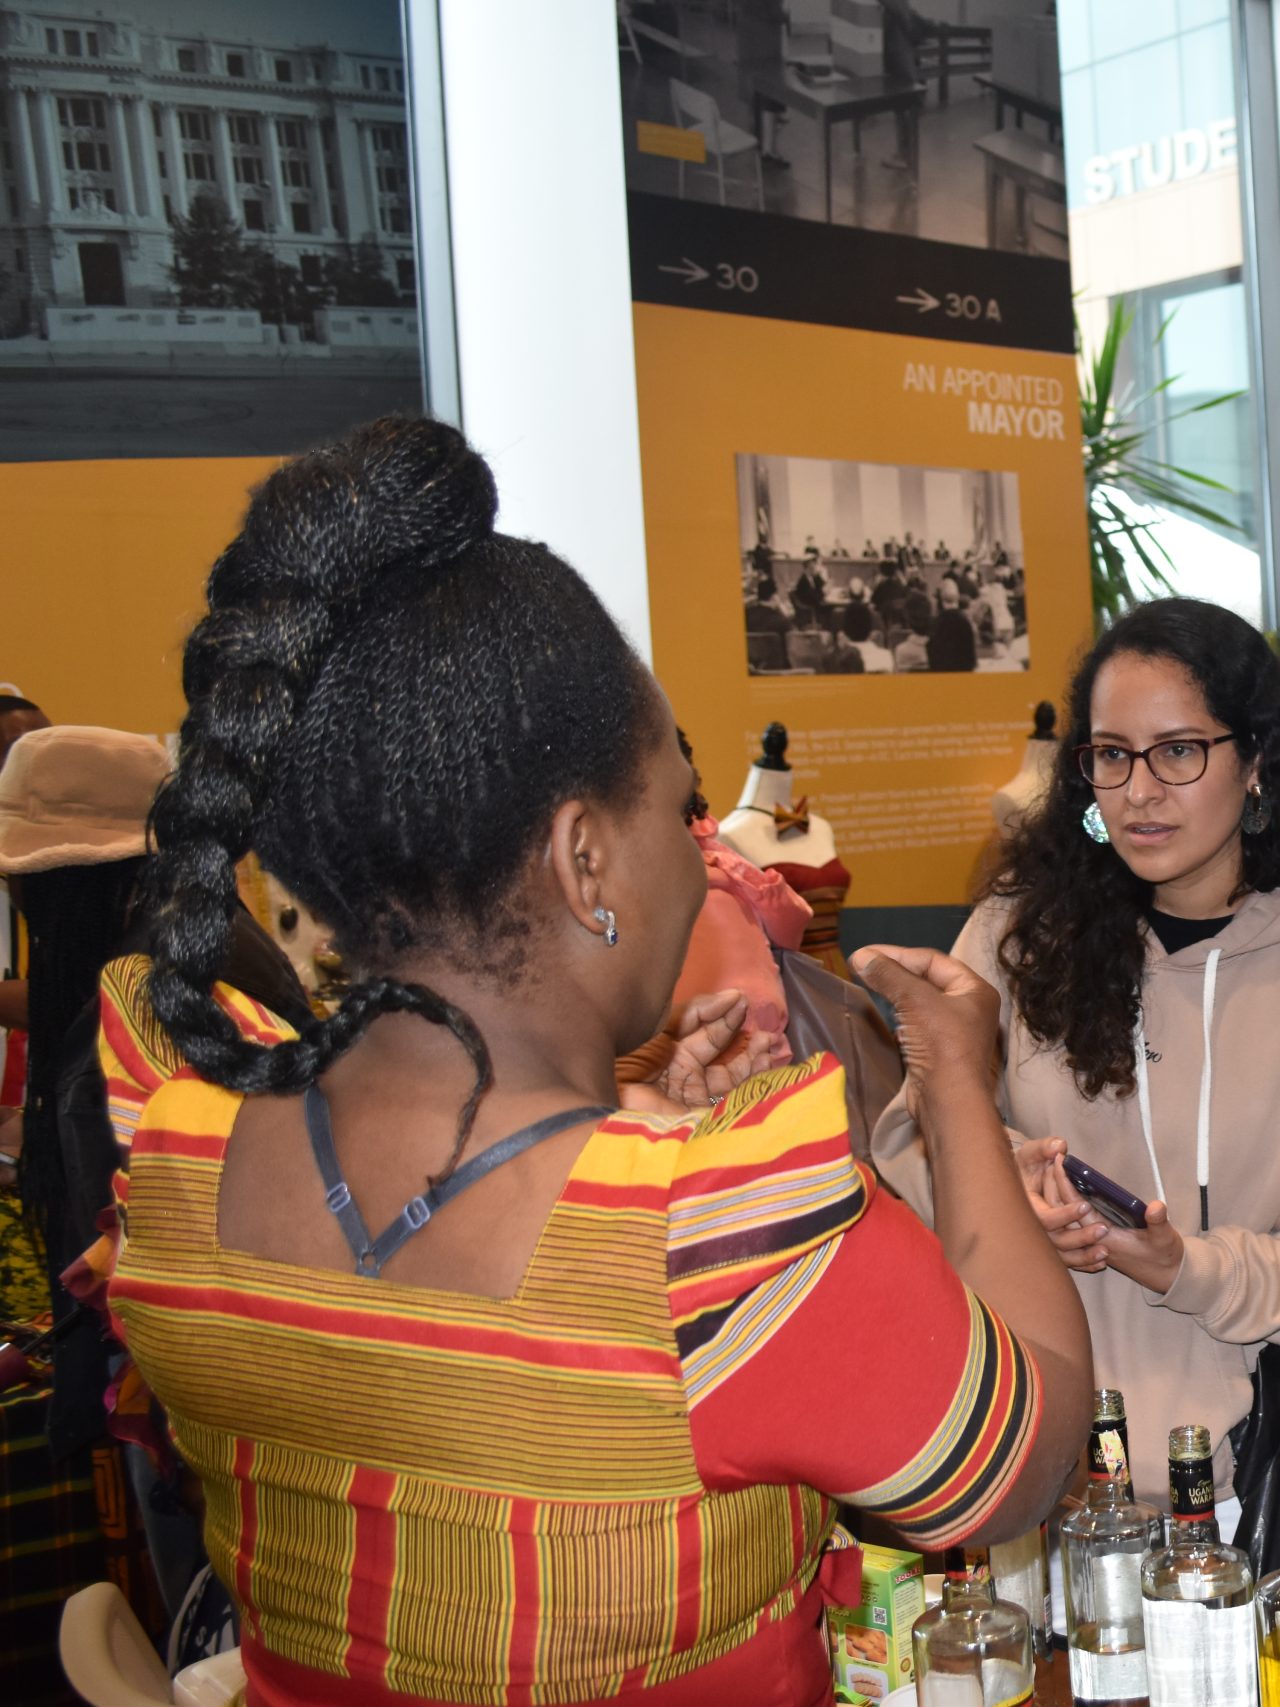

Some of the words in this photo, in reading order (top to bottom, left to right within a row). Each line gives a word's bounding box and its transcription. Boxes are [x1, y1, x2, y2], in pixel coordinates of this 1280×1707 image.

[716, 263, 760, 293] 30
[945, 292, 981, 320] 30
[985, 298, 1002, 322] A
[903, 362, 937, 394] AN
[942, 366, 1064, 407] APPOINTED
[967, 400, 1067, 442] MAYOR
